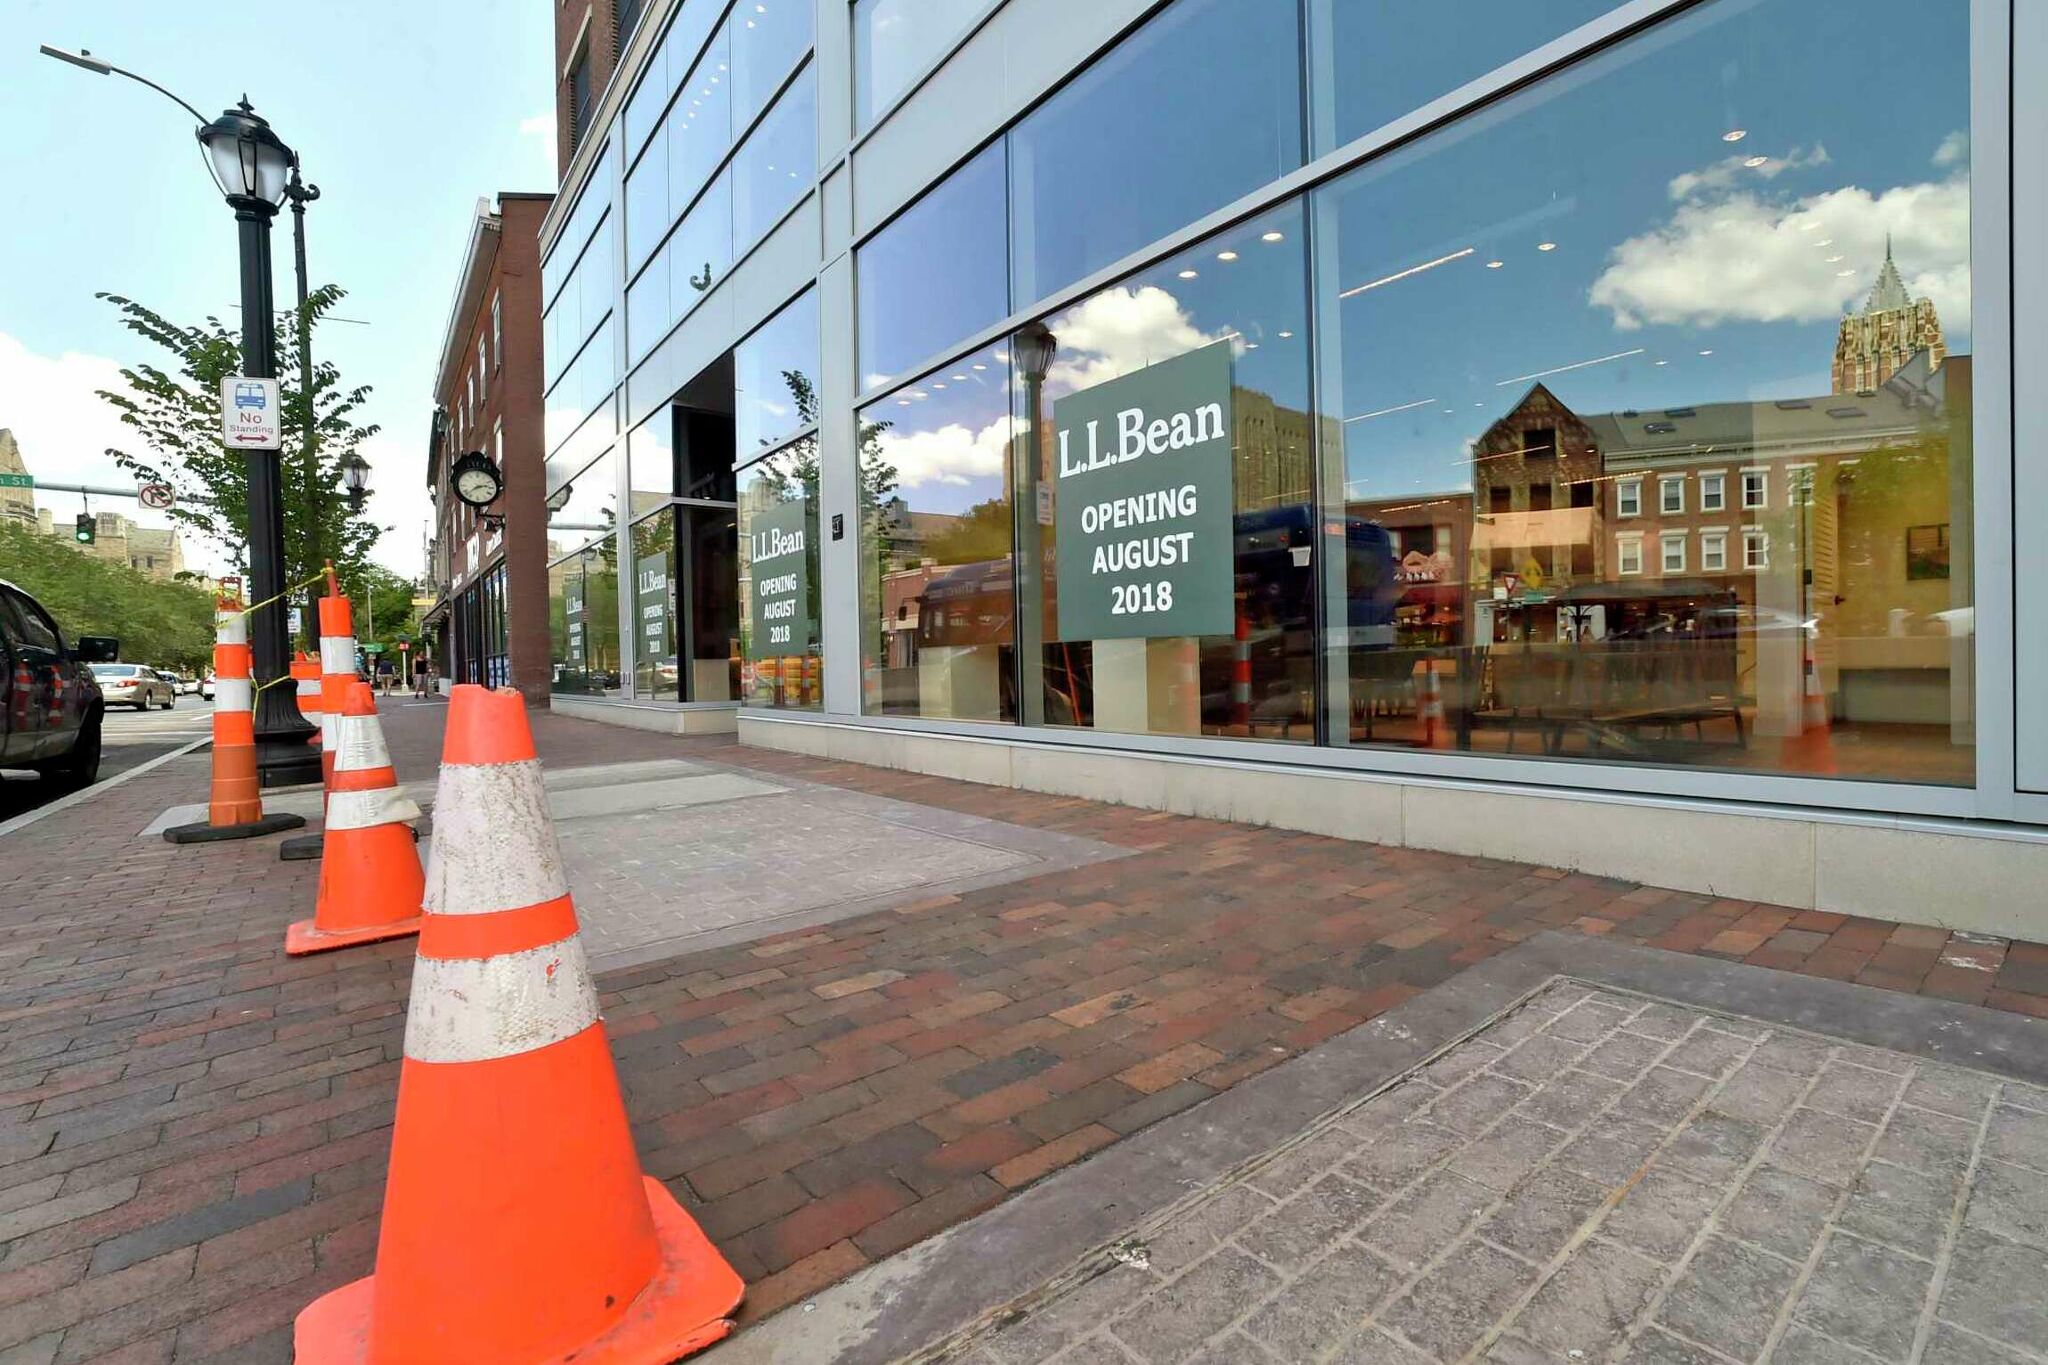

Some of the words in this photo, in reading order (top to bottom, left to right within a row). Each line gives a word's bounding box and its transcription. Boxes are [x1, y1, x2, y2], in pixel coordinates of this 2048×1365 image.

[229, 424, 274, 435] Standing
[240, 412, 263, 424] No
[1058, 400, 1225, 479] L.L.Bean
[12, 476, 27, 486] St
[1081, 484, 1198, 534] OPENING
[752, 528, 805, 563] L.L.Bean
[1092, 532, 1194, 574] AUGUST
[760, 573, 797, 597] OPENING
[763, 599, 796, 621] AUGUST
[1111, 581, 1173, 615] 2018
[770, 625, 791, 644] 2018
